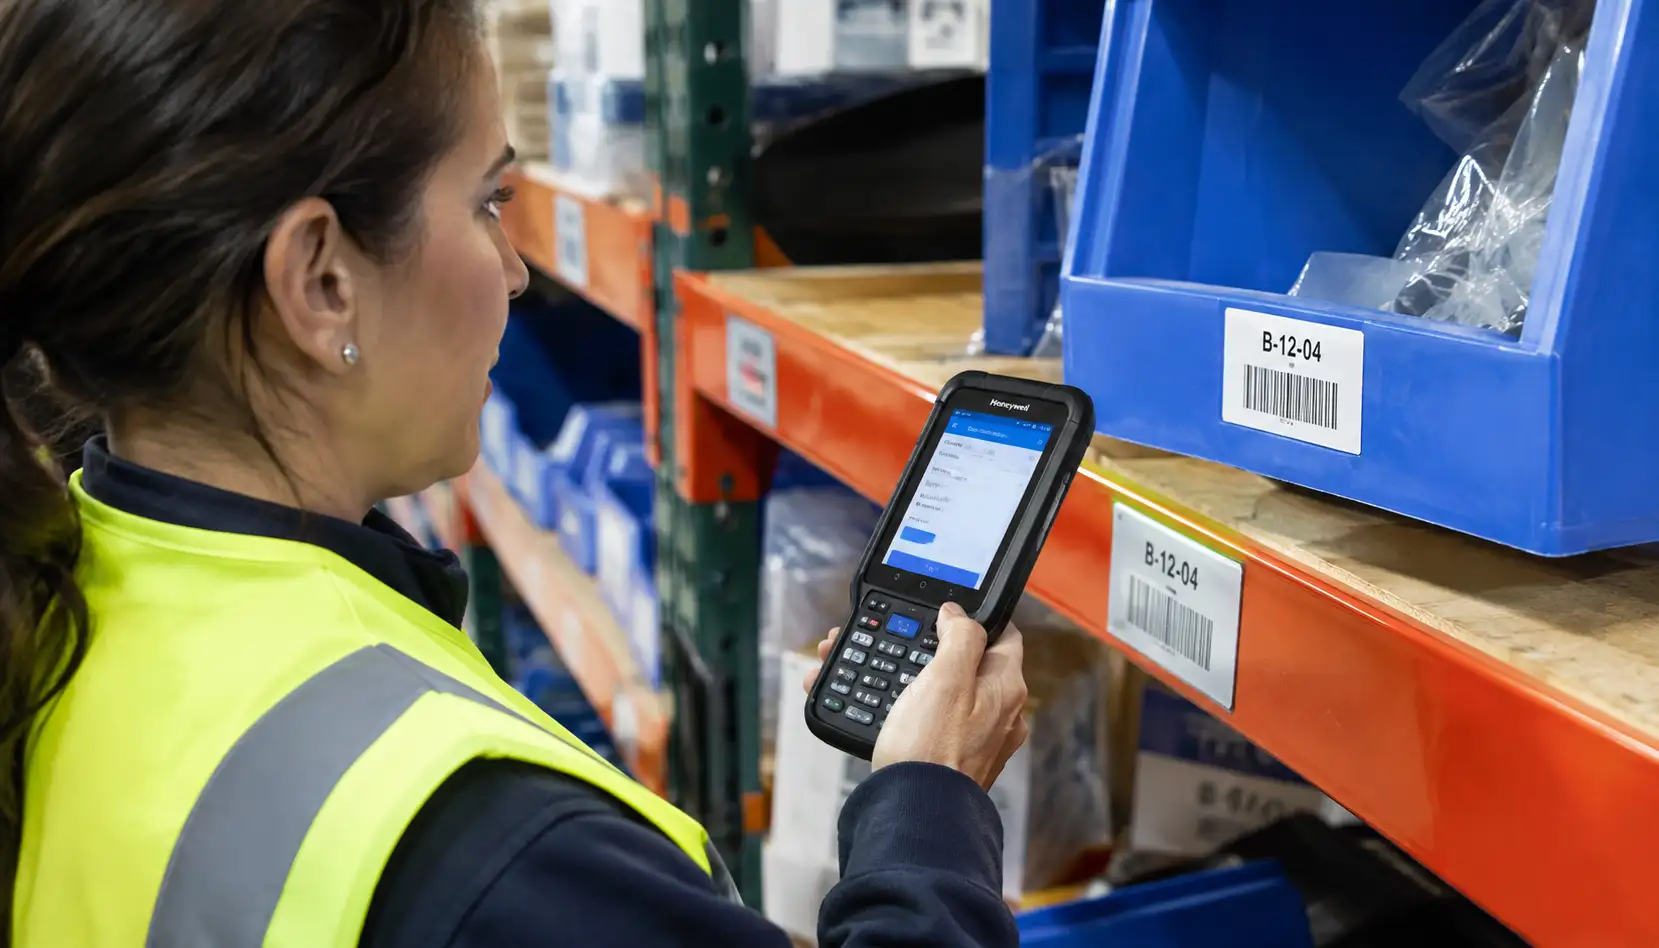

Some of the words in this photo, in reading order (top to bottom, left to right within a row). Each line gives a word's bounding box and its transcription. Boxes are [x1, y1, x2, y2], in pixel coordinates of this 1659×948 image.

[1262, 331, 1321, 362] B-12-04
[989, 399, 1030, 412] Honeywell
[1145, 541, 1199, 590] B-12-04
